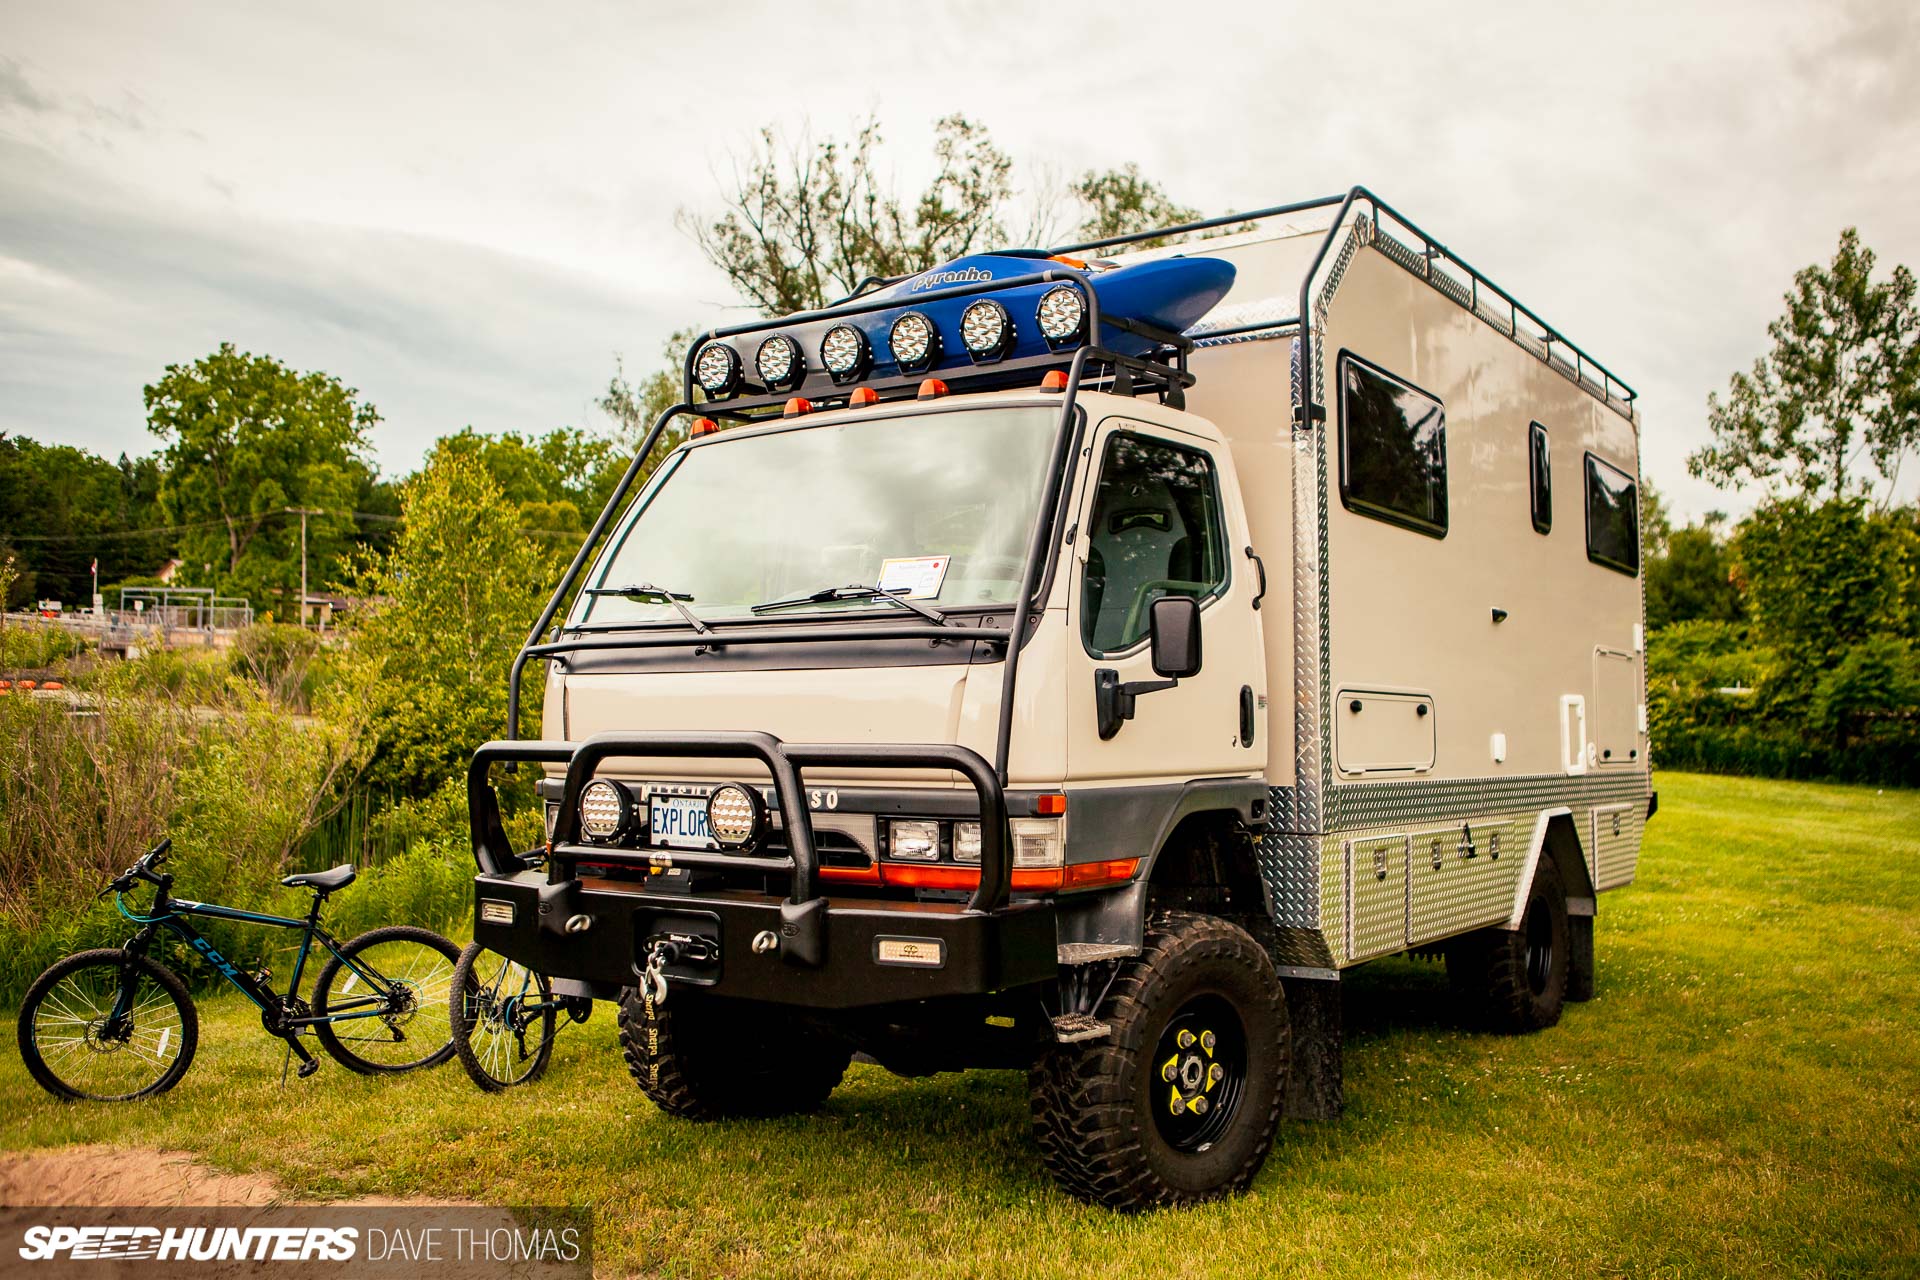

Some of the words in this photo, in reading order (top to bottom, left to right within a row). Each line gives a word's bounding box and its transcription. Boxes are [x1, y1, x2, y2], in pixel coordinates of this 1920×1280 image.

[193, 936, 239, 977] CCM
[645, 993, 656, 1020] Sherpa
[648, 1027, 658, 1056] Sherpa
